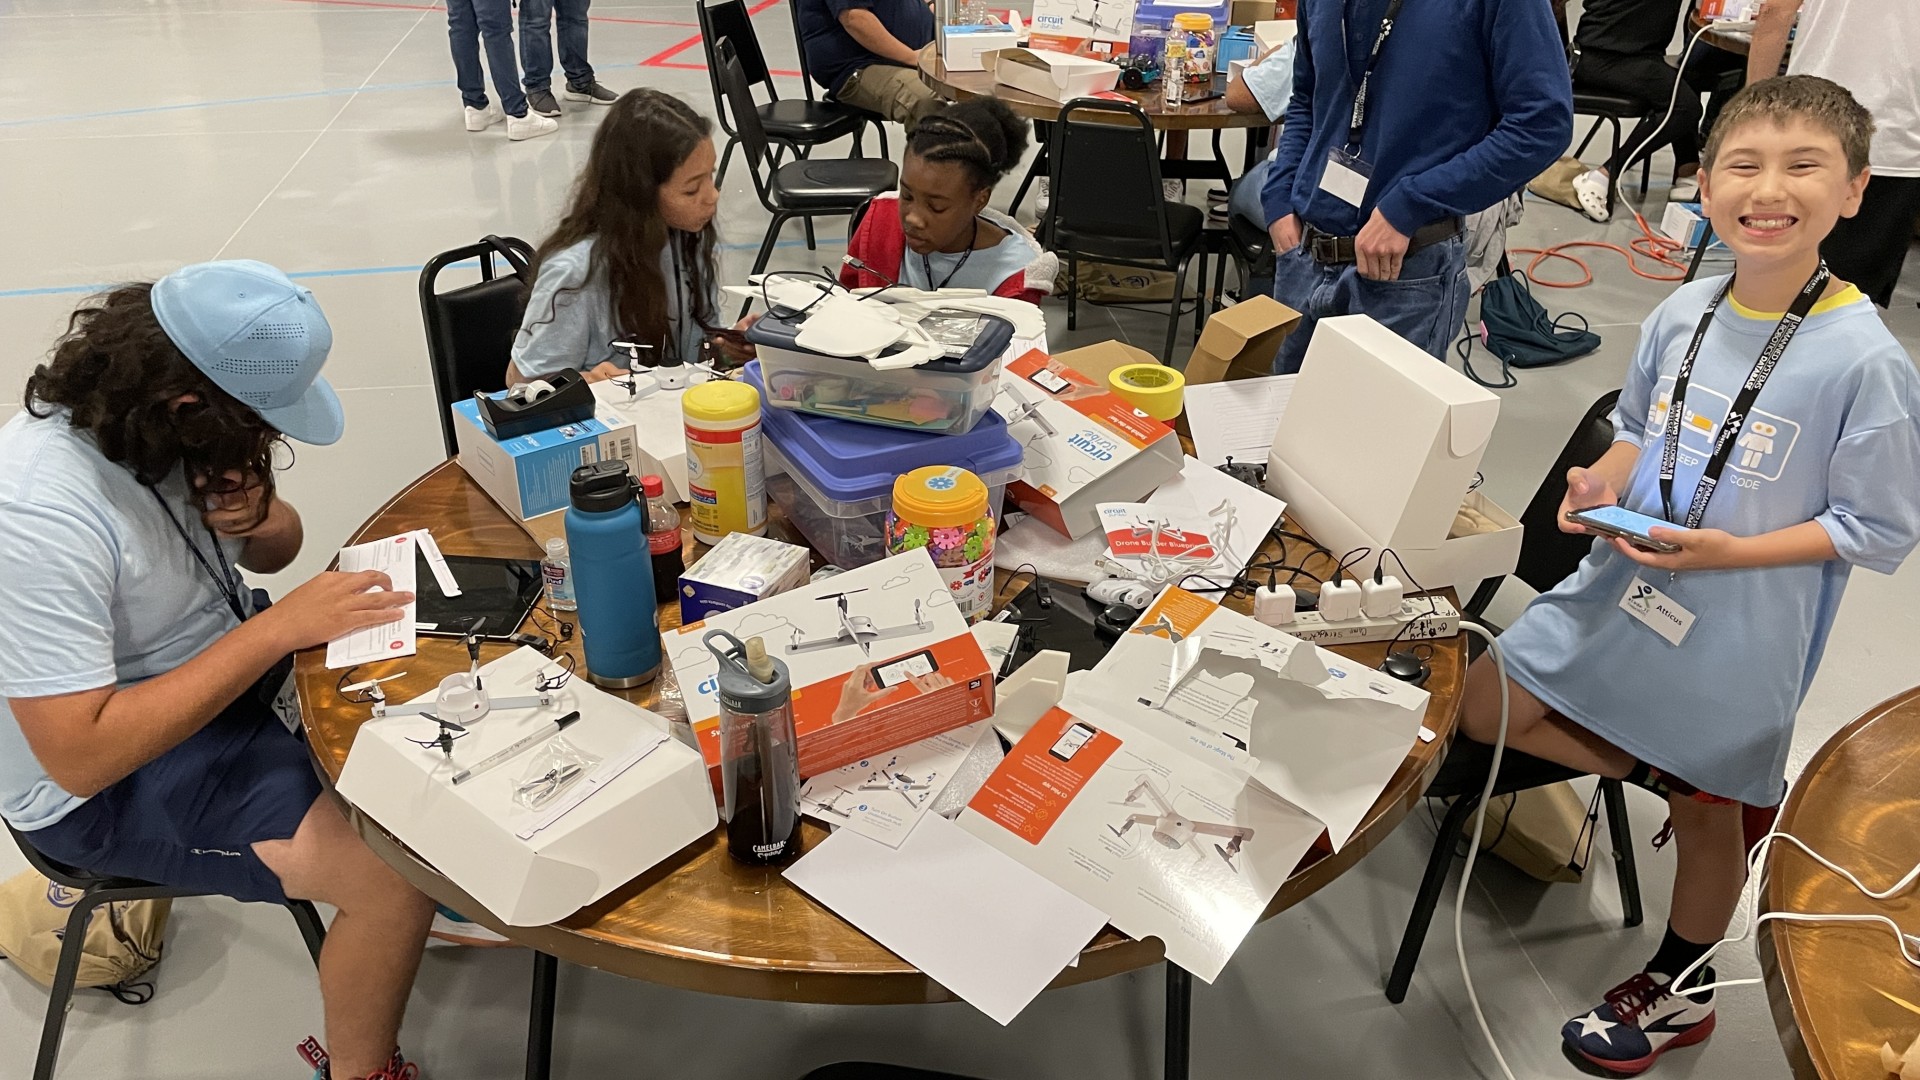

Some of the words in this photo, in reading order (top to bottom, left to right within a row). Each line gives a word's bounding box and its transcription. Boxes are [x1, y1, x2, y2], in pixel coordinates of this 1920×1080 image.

[1763, 323, 1787, 357] ROBOTICS
[1772, 321, 1799, 361] UNMANNED
[1744, 355, 1768, 391] DATABASE
[1754, 360, 1776, 390] SYSTEMS
[1067, 433, 1113, 462] circuit
[1082, 429, 1118, 451] scribe
[1677, 454, 1699, 467] LEEP
[1729, 474, 1761, 490] CODE
[1656, 604, 1684, 626] Atticus
[752, 840, 785, 853] CAMELBAK
